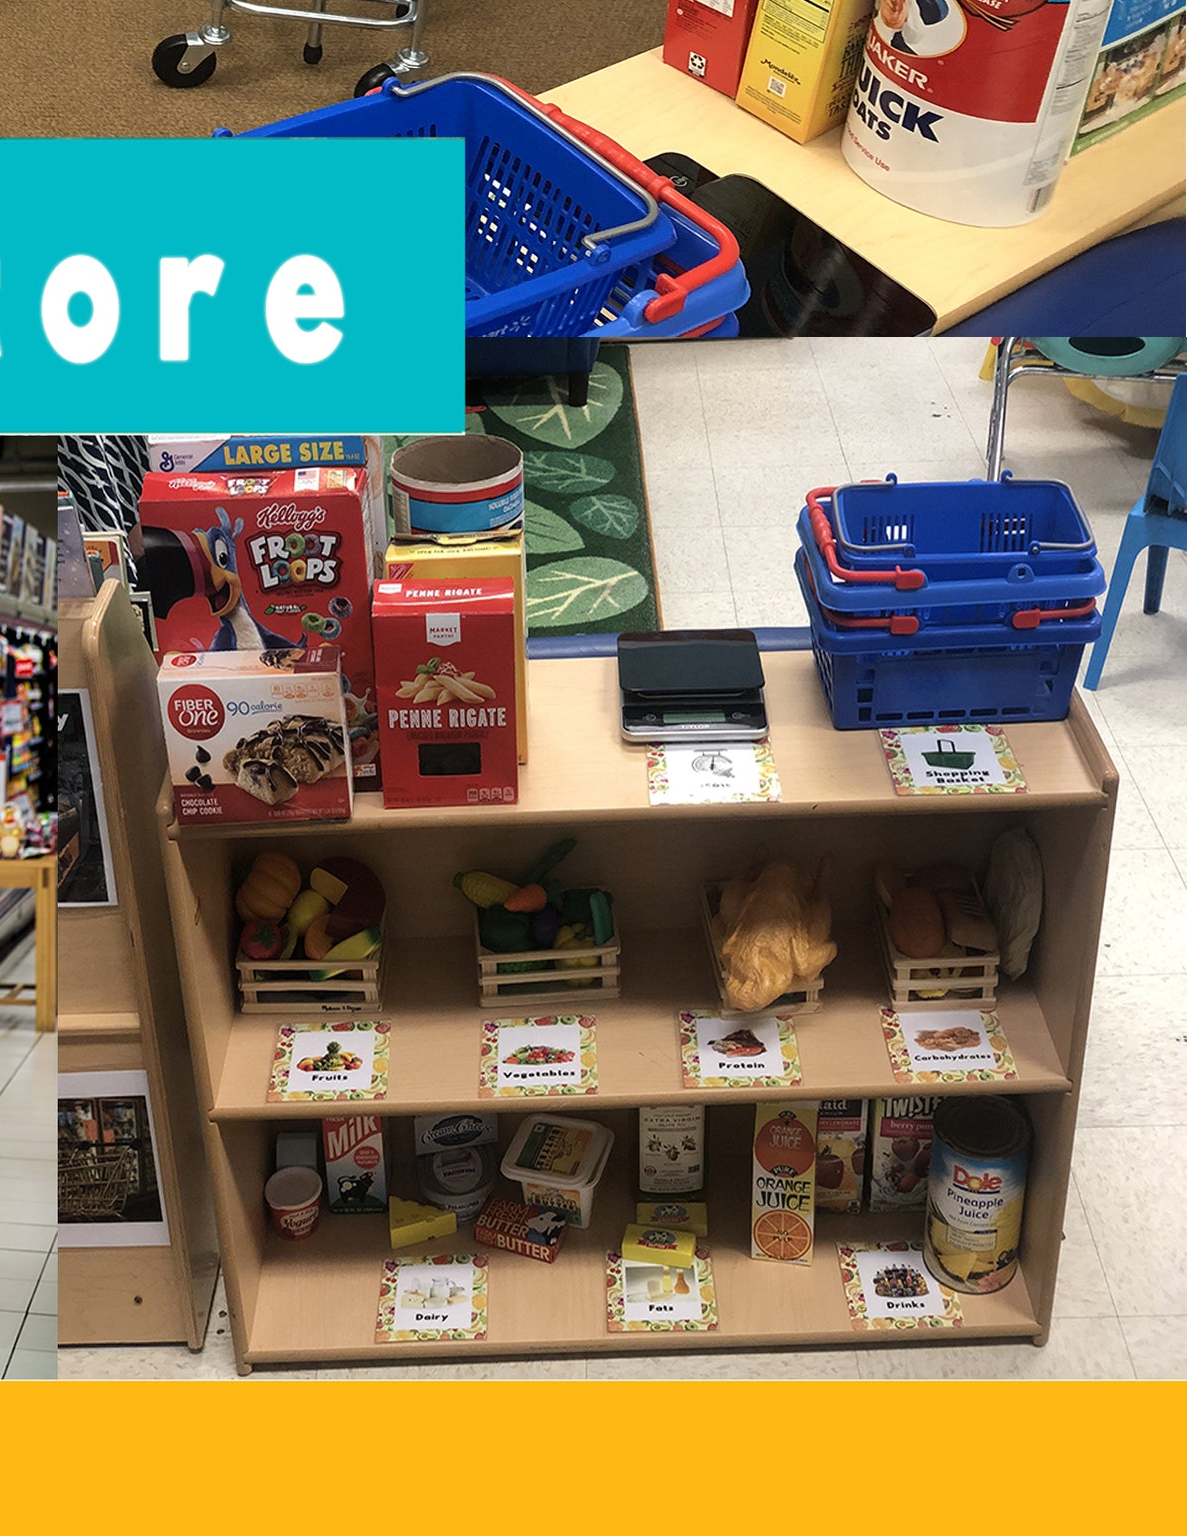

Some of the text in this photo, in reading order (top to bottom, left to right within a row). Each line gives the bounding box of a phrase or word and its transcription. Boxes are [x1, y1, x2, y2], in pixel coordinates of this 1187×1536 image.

[875, 155, 890, 172] Use
[223, 441, 344, 465] LARGE SIZE
[227, 478, 271, 488] FROOT
[230, 485, 270, 495] LOOPS
[256, 503, 327, 532] Kellogg's
[249, 532, 337, 566] FROOT
[259, 558, 337, 589] LOOPS
[405, 587, 483, 598] PENNE RIGATE
[174, 698, 214, 711] FIBER
[226, 700, 284, 716] 90 calorie
[388, 707, 507, 729] PENNE RIGATE
[925, 770, 990, 782] Shopping
[935, 777, 984, 785] Basket
[181, 798, 218, 807] CHOCOLATE
[182, 807, 223, 815] CHIP COOKIE
[914, 1052, 992, 1063] Carbohydrates
[718, 1061, 765, 1070] Protein
[312, 1073, 349, 1083] Fruits
[503, 1069, 576, 1080] Vegetables
[769, 1125, 803, 1136] ORANGE
[890, 1120, 913, 1129] berry
[327, 1115, 378, 1160] Milk
[421, 1124, 456, 1145] Cream
[770, 1135, 802, 1150] JUICE
[953, 1164, 1003, 1191] Dole
[756, 1176, 811, 1194] ORANGE
[756, 1191, 811, 1212] JUICE
[947, 1187, 1004, 1210] Pineapple
[489, 1199, 530, 1215] FARM
[959, 1205, 989, 1219] Juice
[485, 1207, 527, 1224] FRESH
[476, 1214, 530, 1238] BUTTER
[497, 1233, 550, 1262] BUTTER
[649, 1303, 674, 1312] Fats
[886, 1300, 925, 1309] Drinks
[415, 1312, 449, 1323] Dairy
